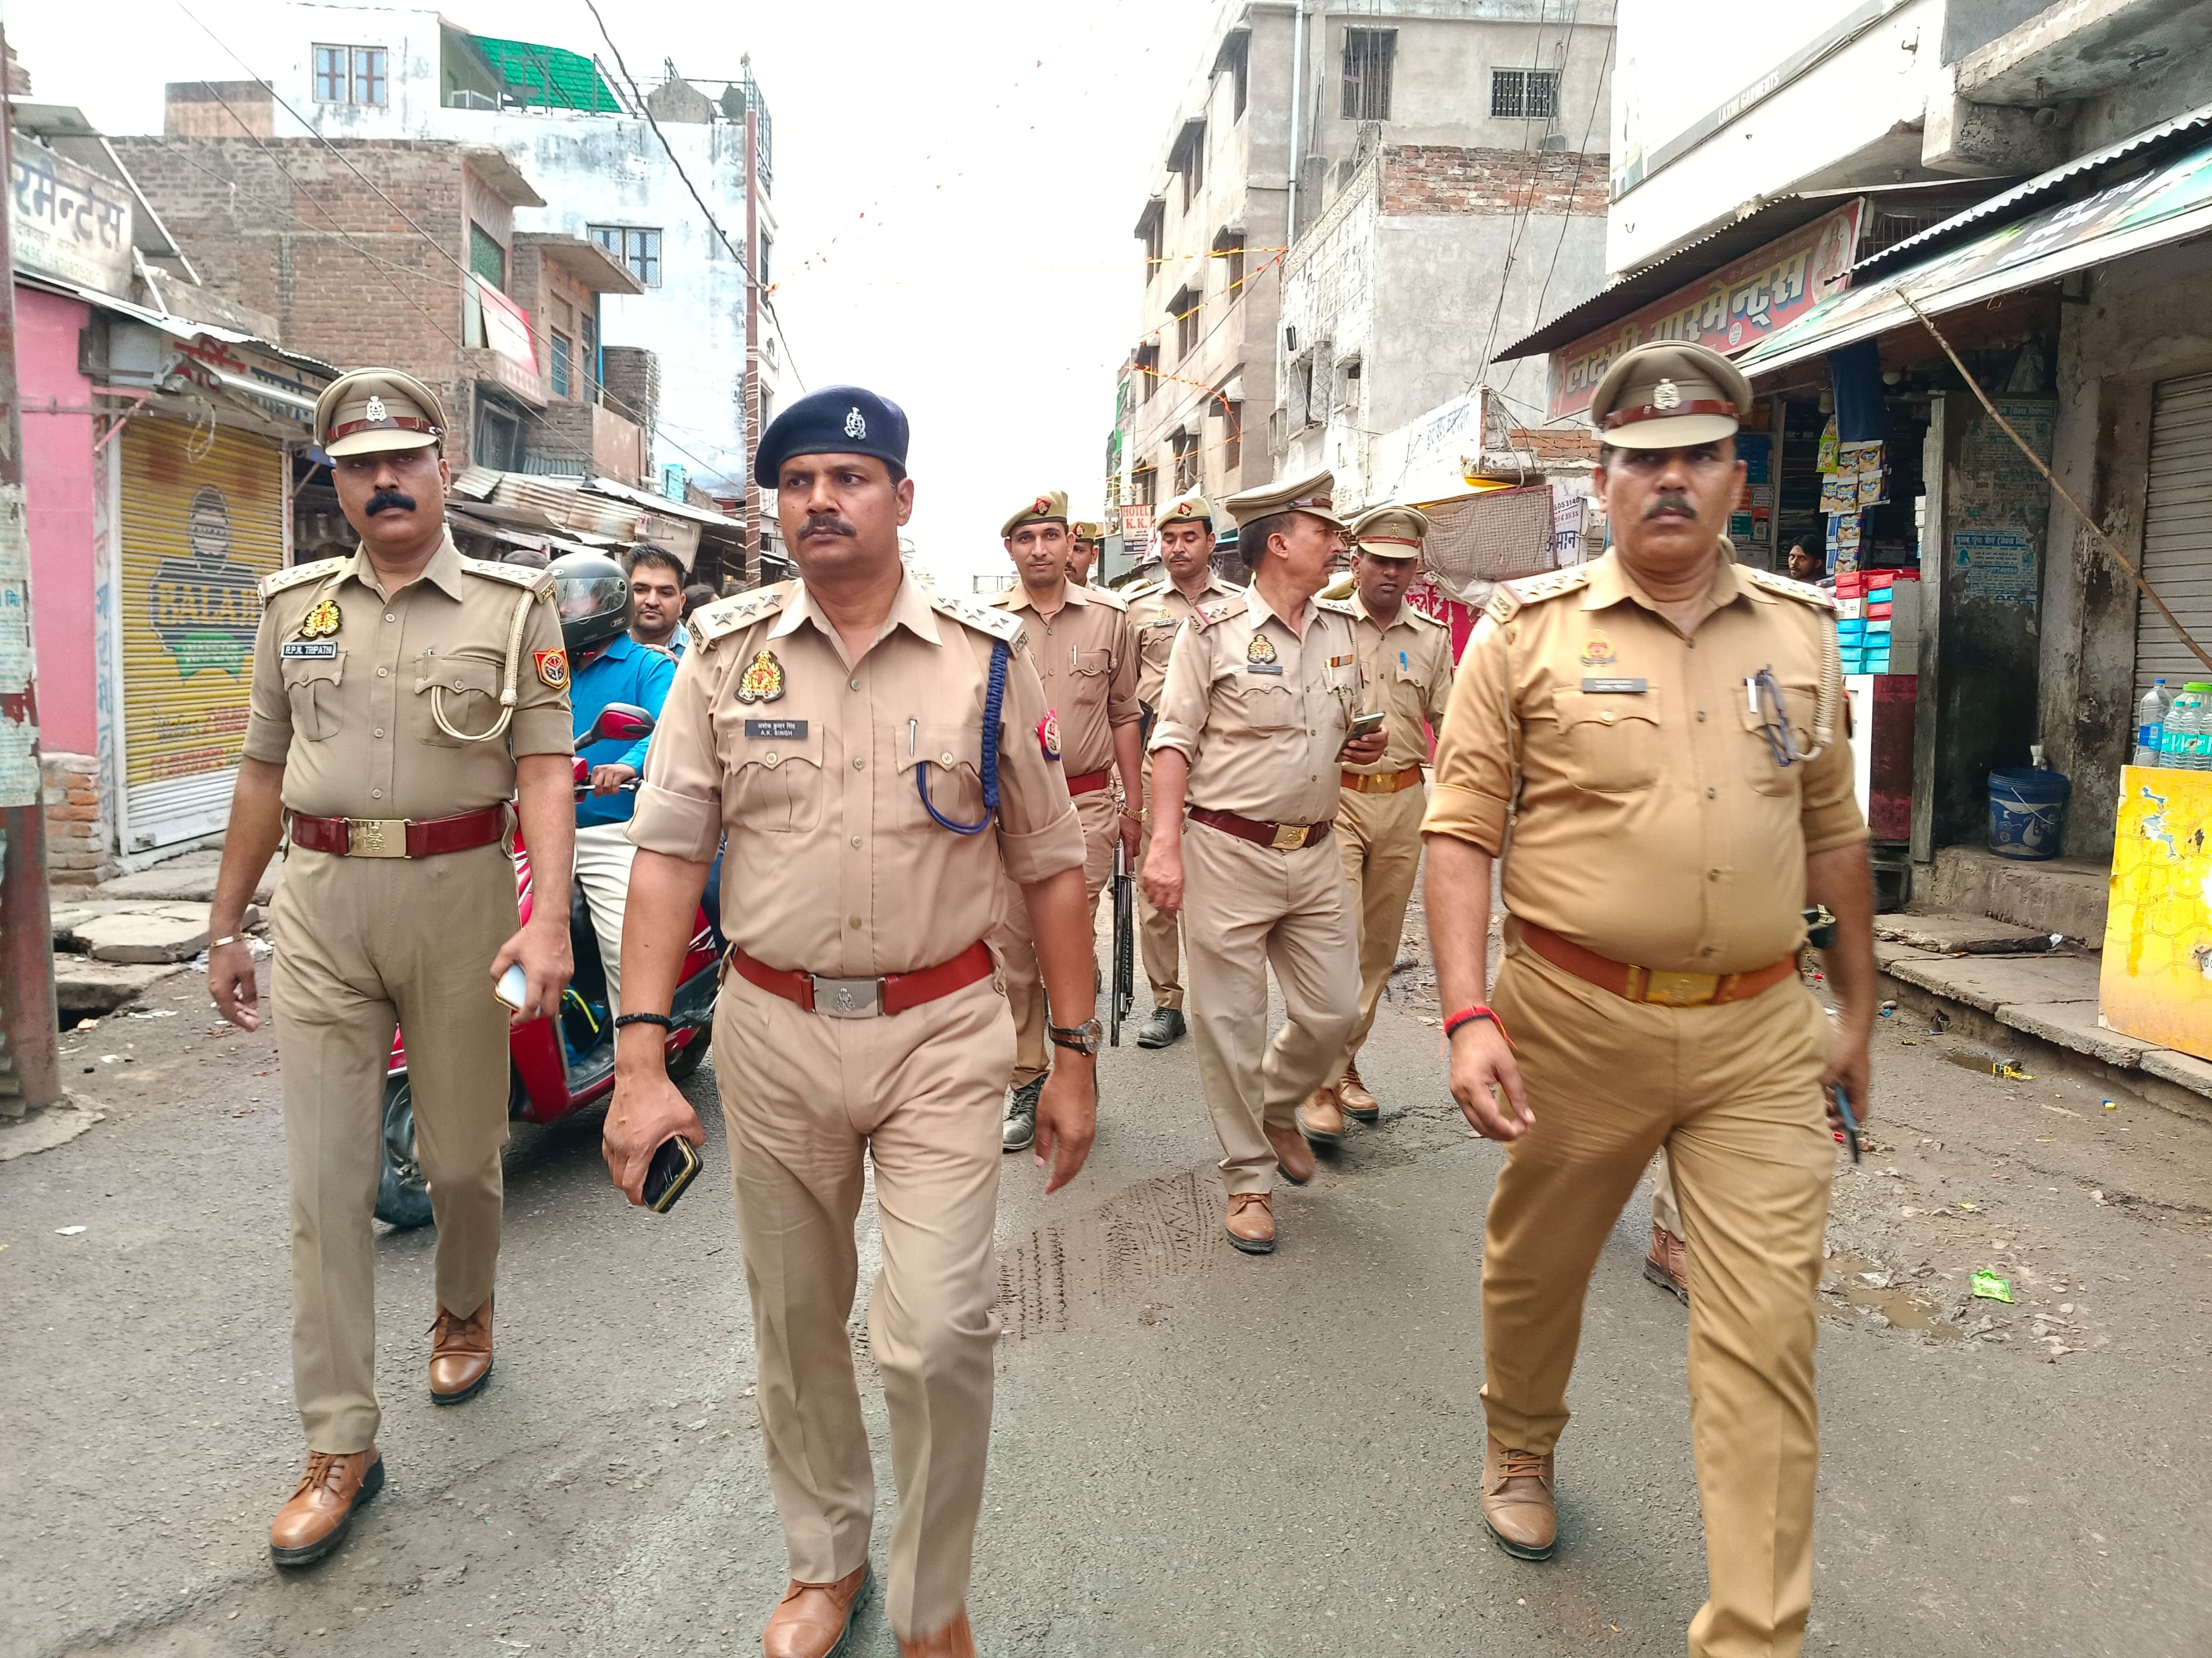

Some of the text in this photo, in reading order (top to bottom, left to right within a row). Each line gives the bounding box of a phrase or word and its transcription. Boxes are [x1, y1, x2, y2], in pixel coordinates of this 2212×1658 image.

[1718, 70, 1779, 125] LAXMI GARMENTS
[1122, 506, 1149, 517] HOTEL
[305, 645, 332, 654] TRIPATHI
